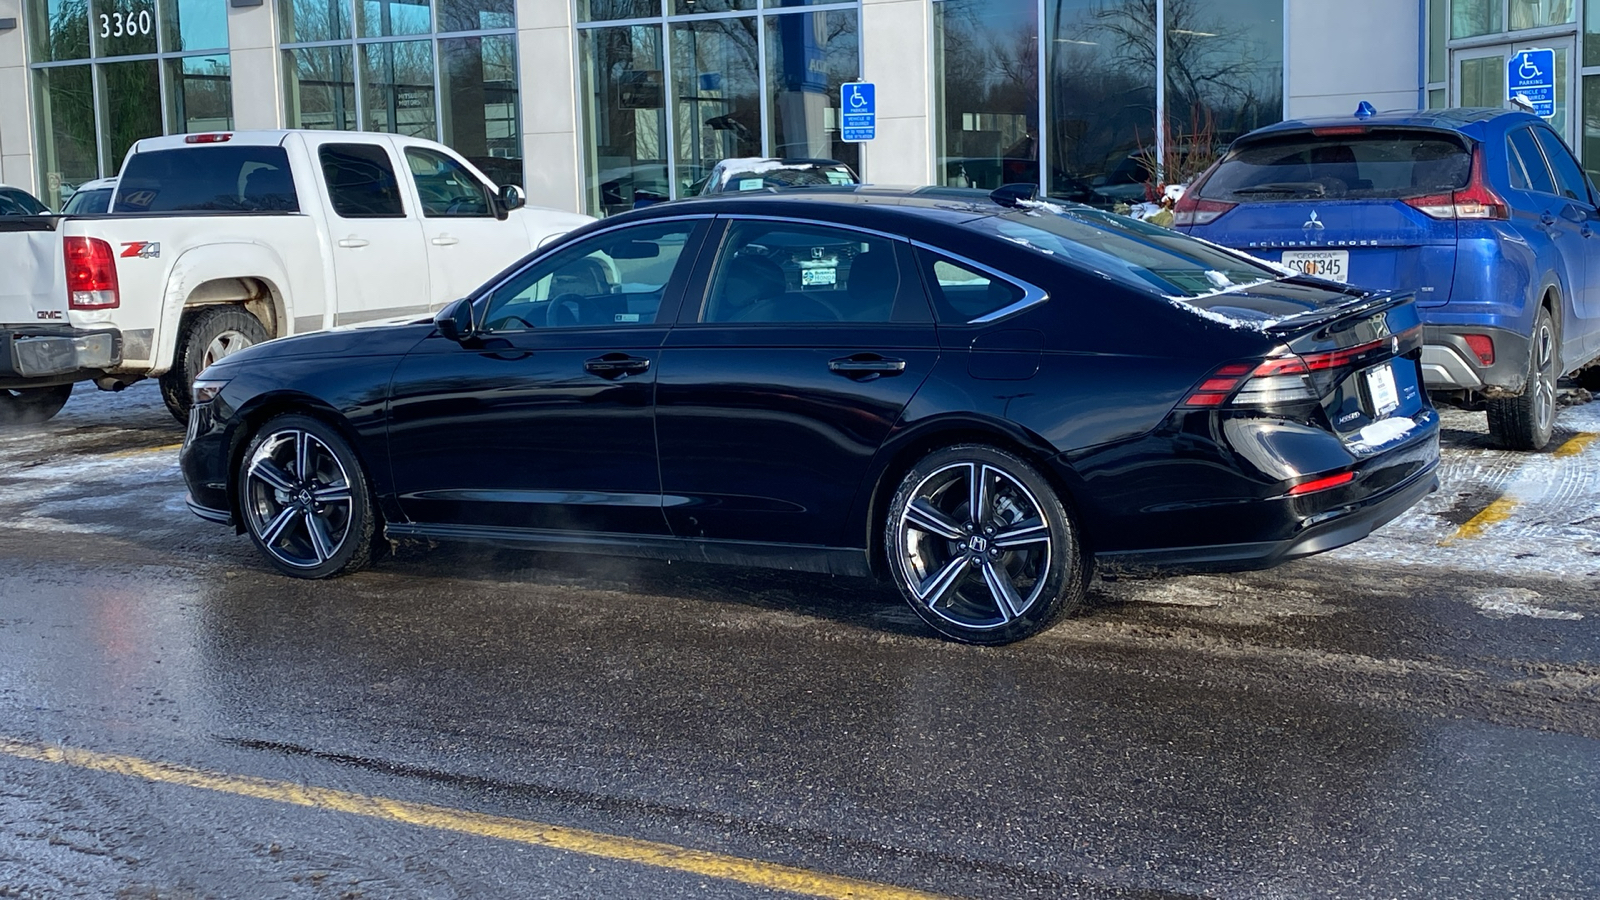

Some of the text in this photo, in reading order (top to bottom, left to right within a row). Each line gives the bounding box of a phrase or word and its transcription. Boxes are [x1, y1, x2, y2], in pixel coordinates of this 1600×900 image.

[100, 10, 150, 38] 3360
[120, 241, 160, 258] Z71
[37, 310, 62, 319] GMC
